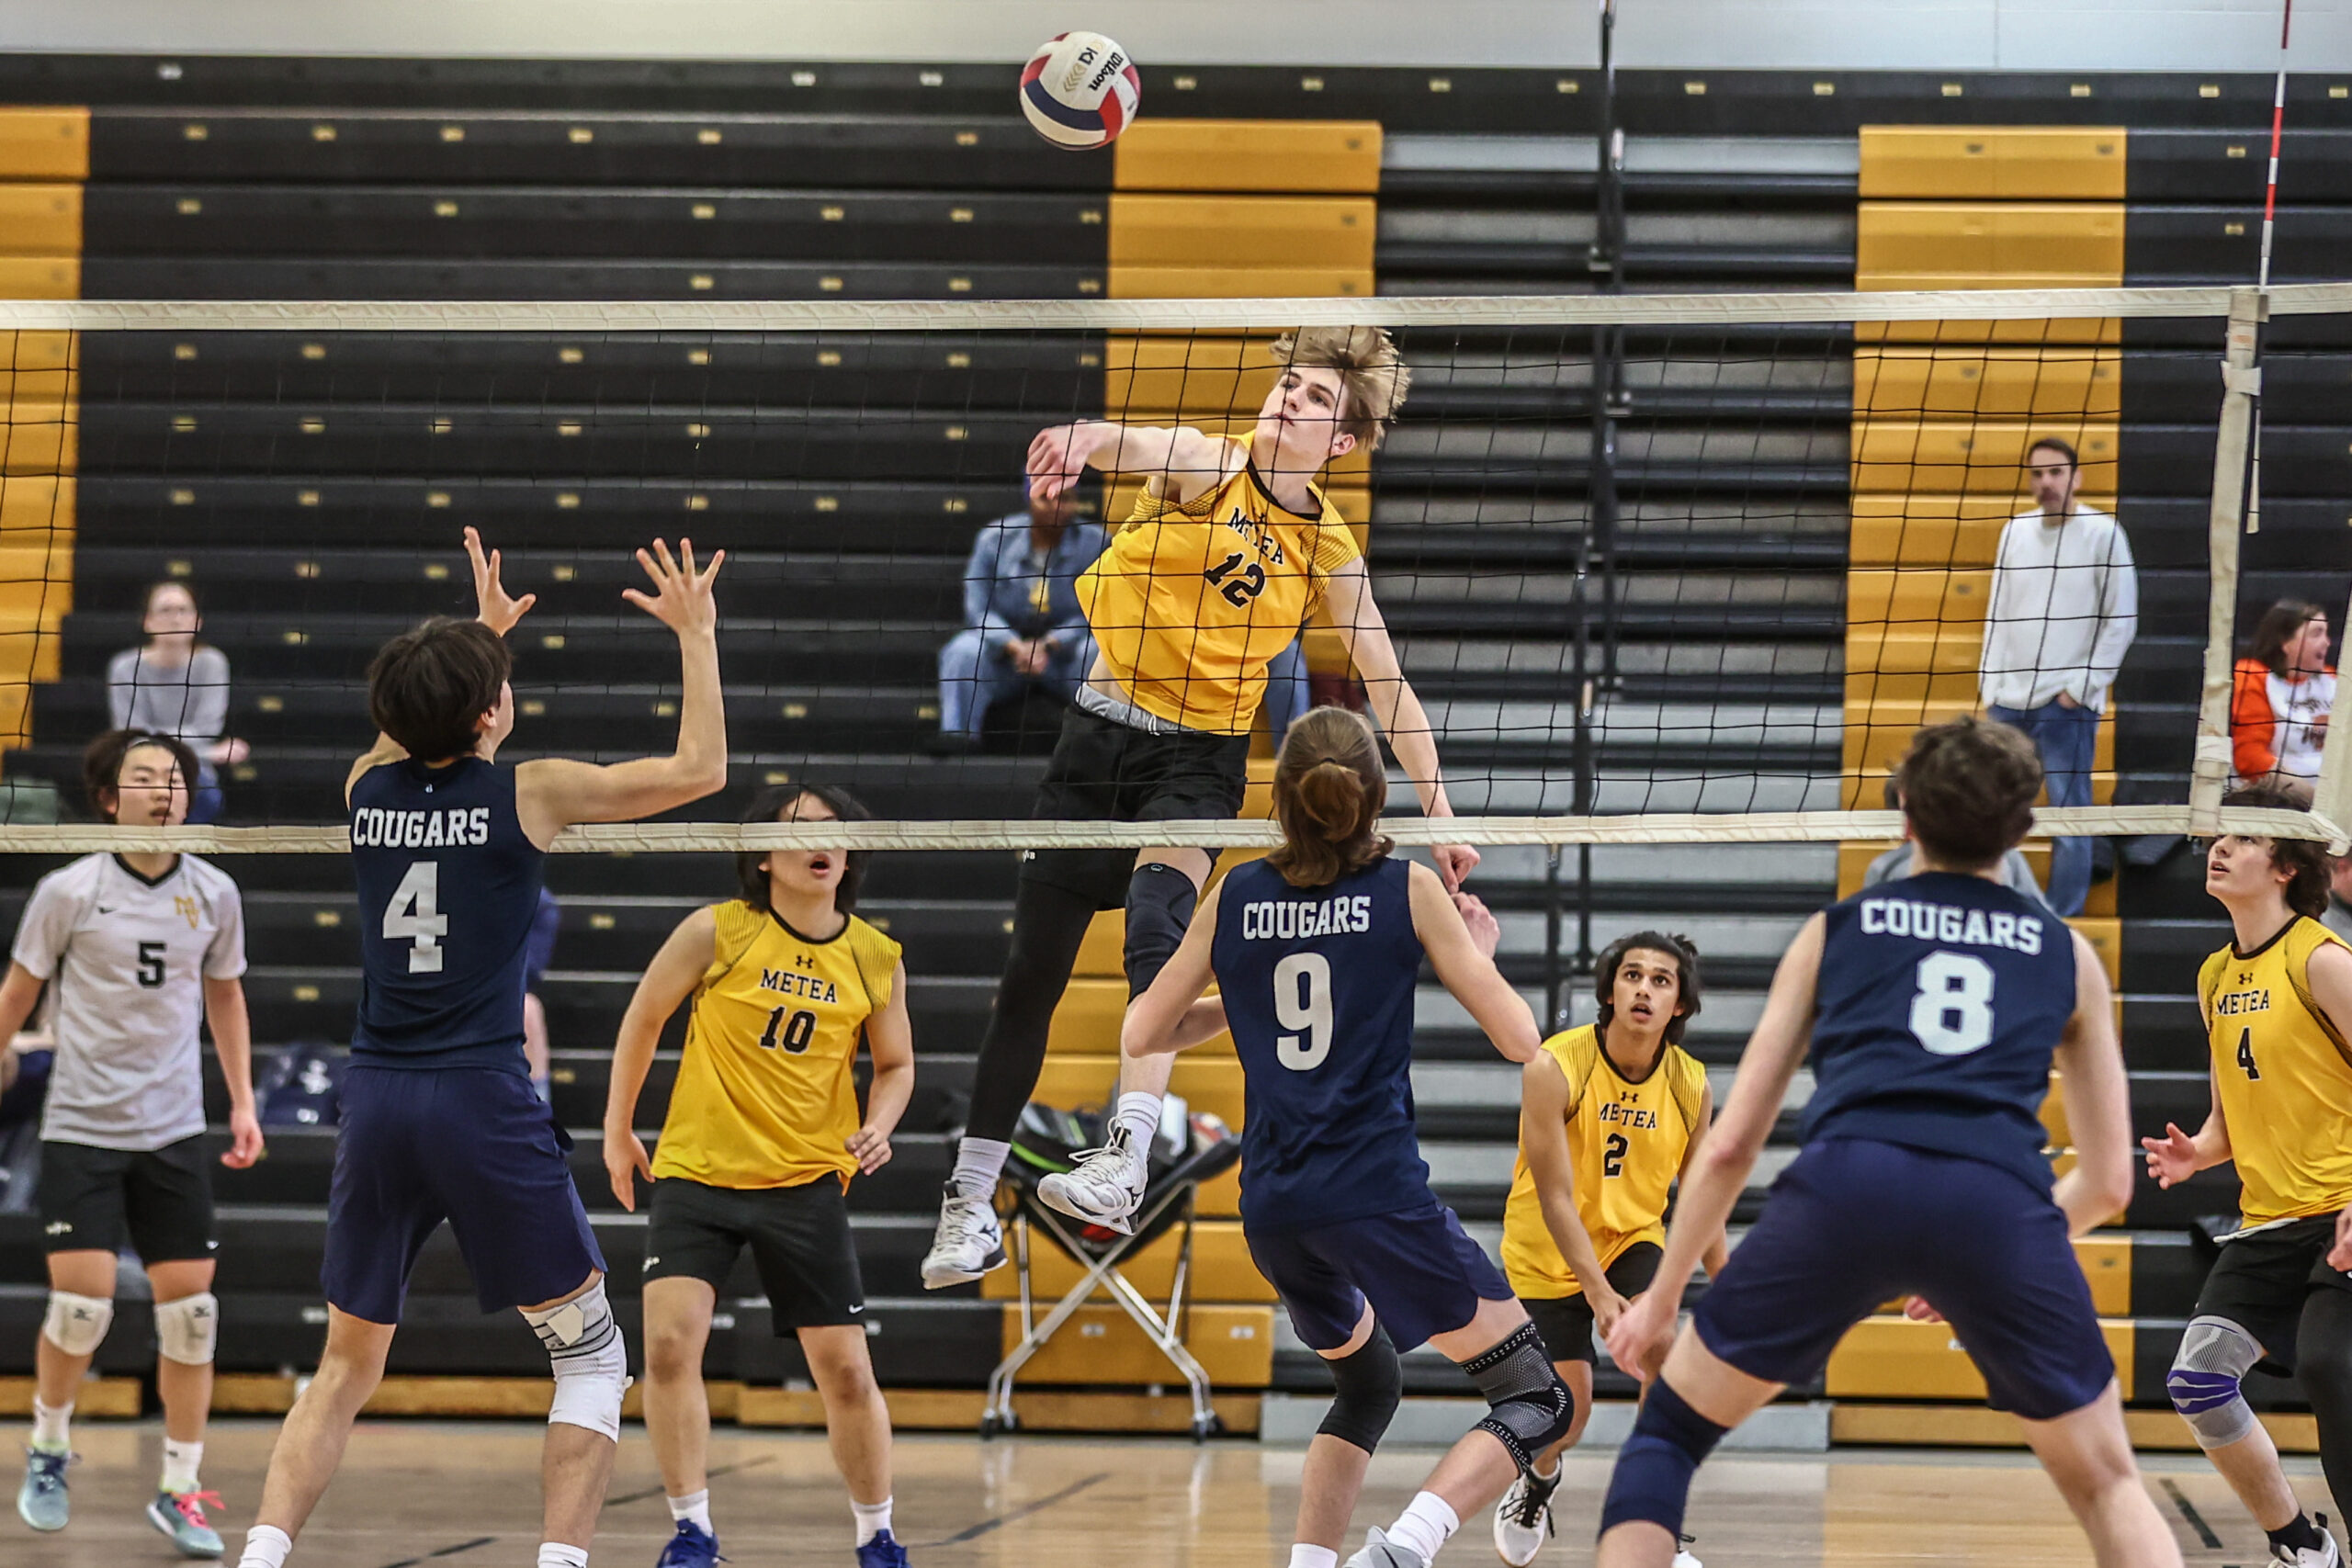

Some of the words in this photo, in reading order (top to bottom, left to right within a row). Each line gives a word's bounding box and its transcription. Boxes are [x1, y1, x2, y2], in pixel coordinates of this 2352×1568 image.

[1088, 53, 1124, 92] Wilson
[1205, 553, 1266, 608] 12
[353, 807, 490, 848] COUGARS
[383, 861, 447, 974] 4
[1243, 896, 1371, 941] COUGARS
[1860, 898, 2042, 955] COUGARS
[137, 942, 166, 988] 5
[761, 969, 837, 1003] METEA
[1273, 952, 1334, 1071] 9
[1908, 950, 1996, 1055] 8
[2215, 990, 2269, 1016] METEA
[760, 1006, 818, 1054] 10
[2236, 1026, 2260, 1081] 4
[1599, 1103, 1657, 1129] METEA
[1604, 1133, 1628, 1178] 2
